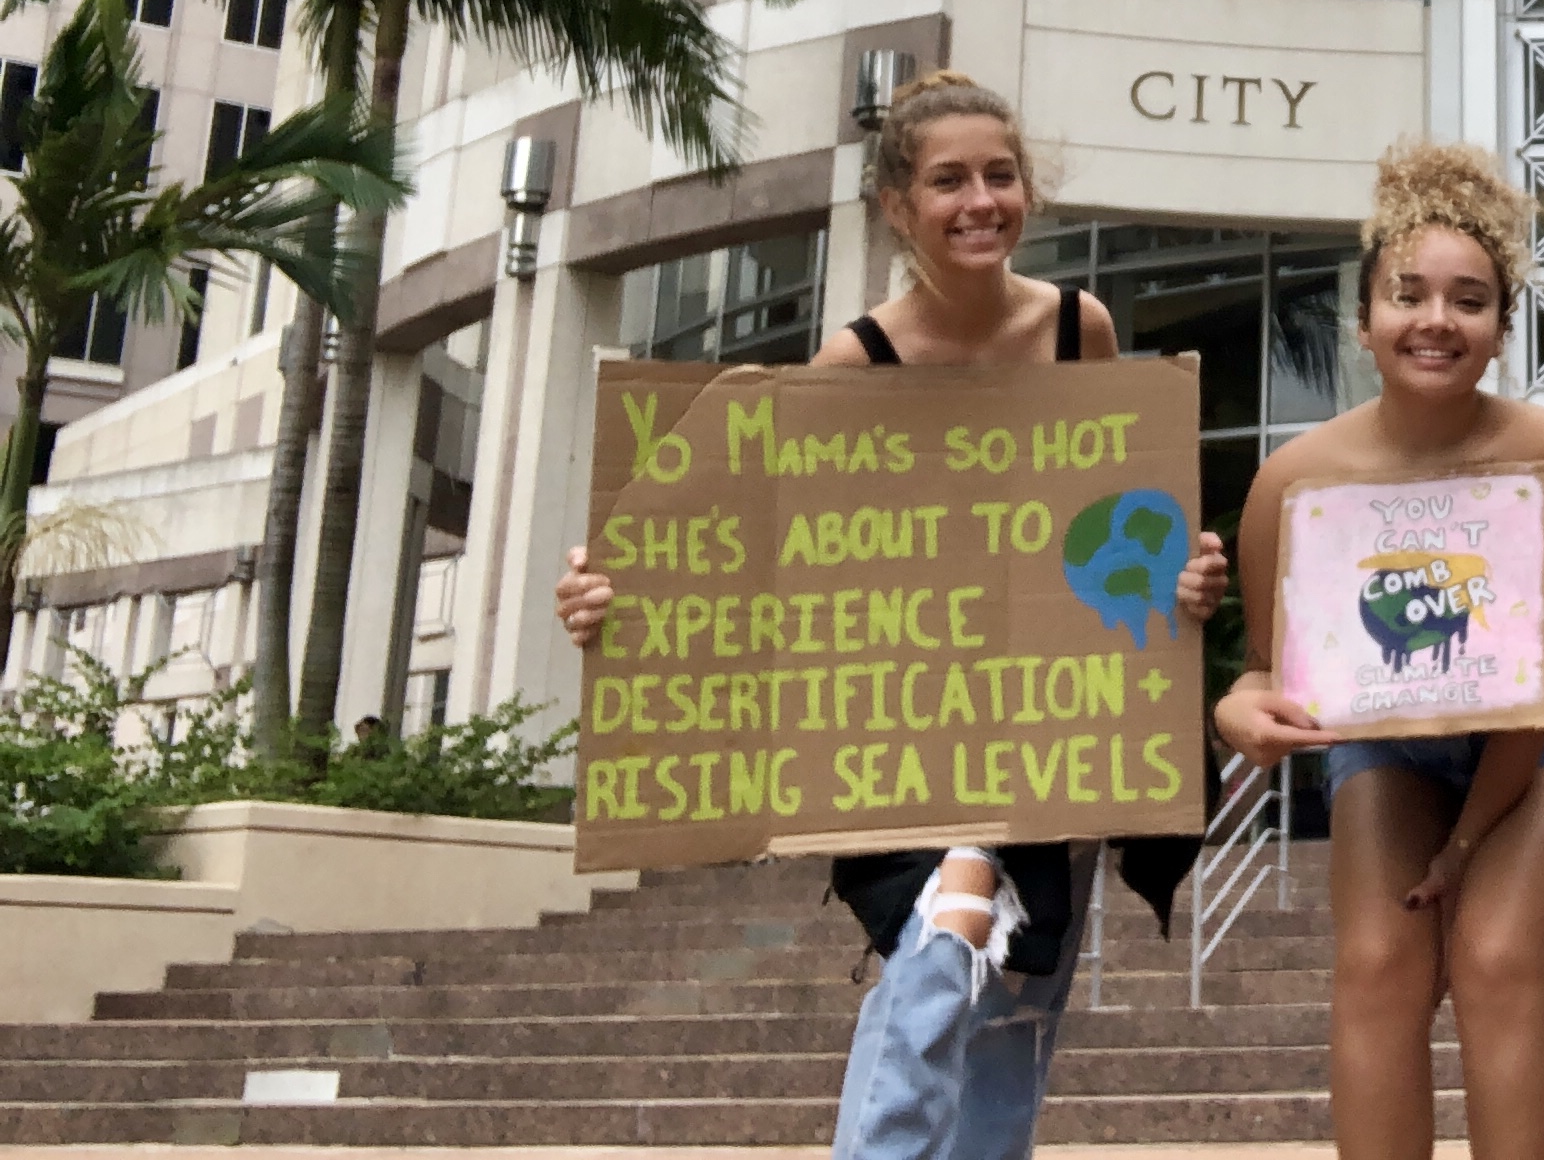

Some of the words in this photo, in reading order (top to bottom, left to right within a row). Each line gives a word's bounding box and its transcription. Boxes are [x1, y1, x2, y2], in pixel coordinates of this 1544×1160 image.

[1130, 71, 1318, 129] CITY
[944, 426, 1017, 473] SO
[1032, 412, 1139, 471] HOT
[603, 505, 746, 574] SHE'S
[778, 504, 948, 567] ABOUT
[971, 499, 1051, 554] TO
[1370, 494, 1453, 524] YOU
[1375, 520, 1489, 554] CAN'T
[1362, 559, 1451, 601] COMB
[1405, 576, 1497, 624] OVER
[601, 585, 987, 660] EXPERIENCE
[591, 652, 1124, 735] DESERTIFICATION
[1350, 680, 1481, 713] CHANGE
[586, 747, 802, 821] RISING
[831, 742, 931, 812] SEA
[953, 732, 1182, 805] LEVELS
